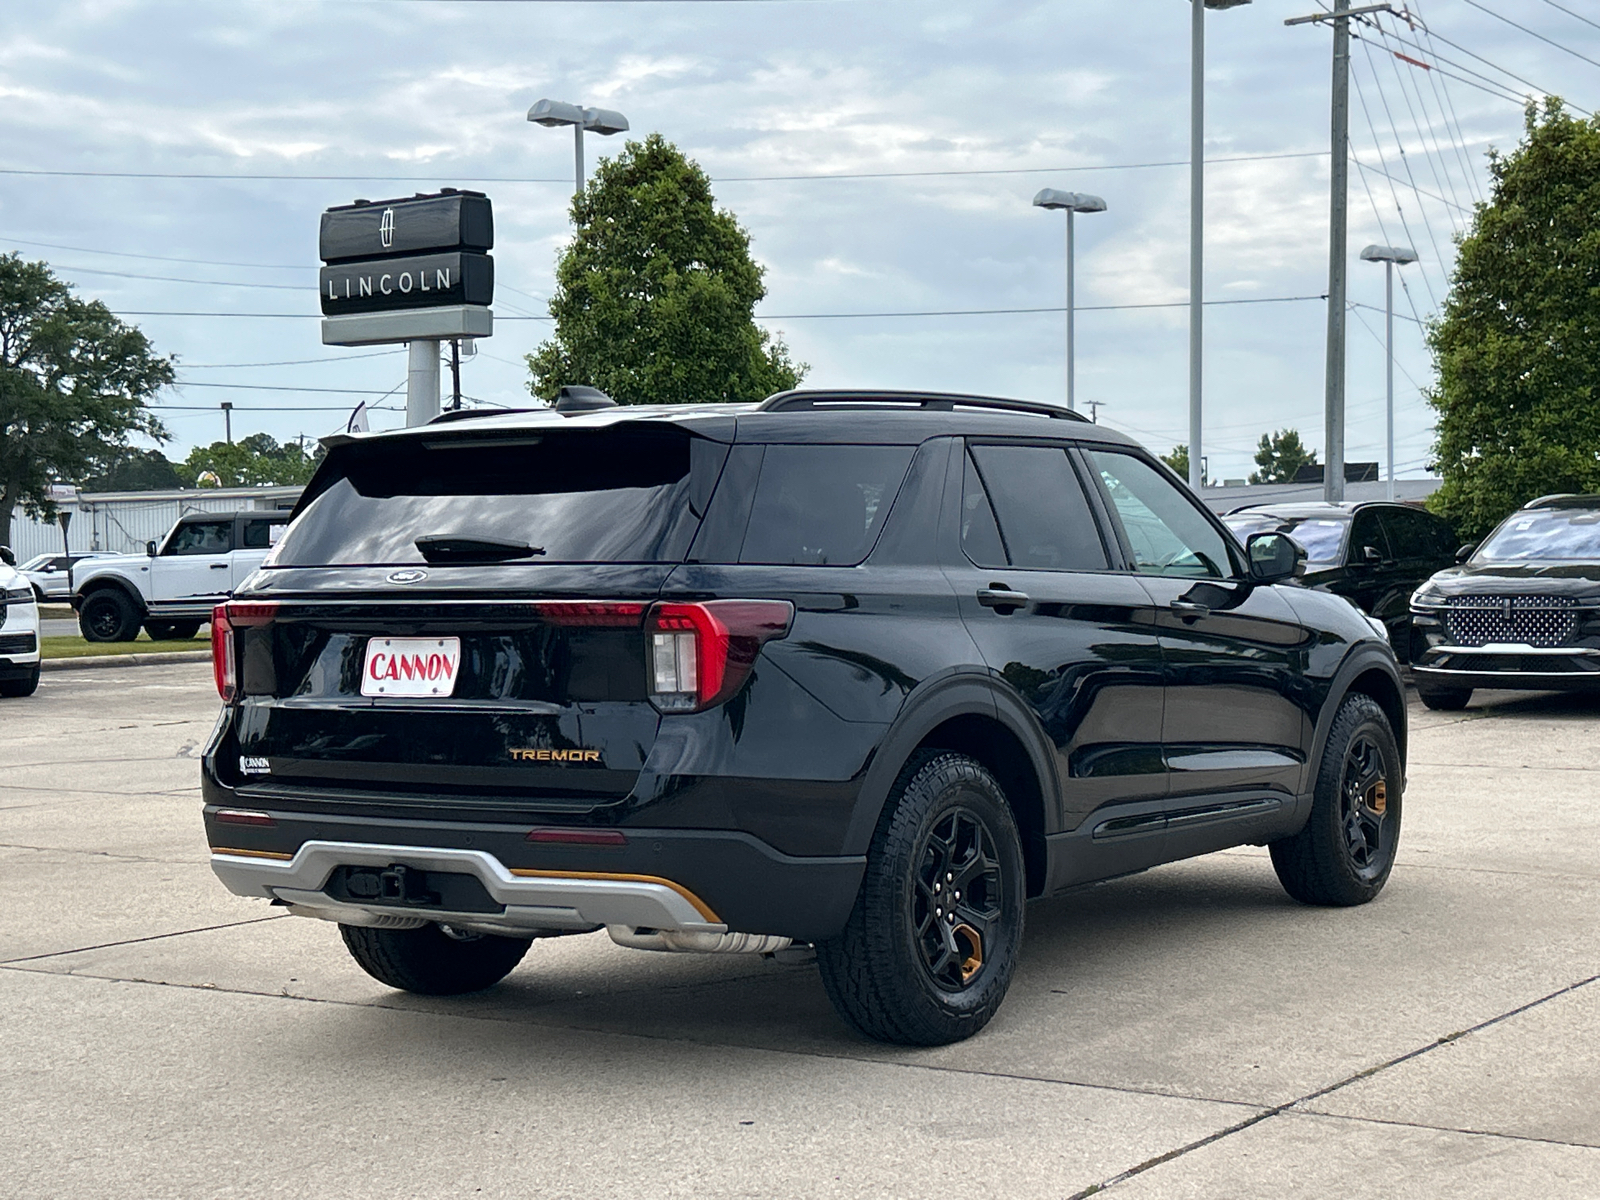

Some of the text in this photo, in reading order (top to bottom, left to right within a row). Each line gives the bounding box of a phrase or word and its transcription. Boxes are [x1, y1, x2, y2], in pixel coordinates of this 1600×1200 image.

[329, 267, 451, 300] LINCOLN
[369, 652, 456, 681] CANNON
[509, 748, 602, 762] TREMOR
